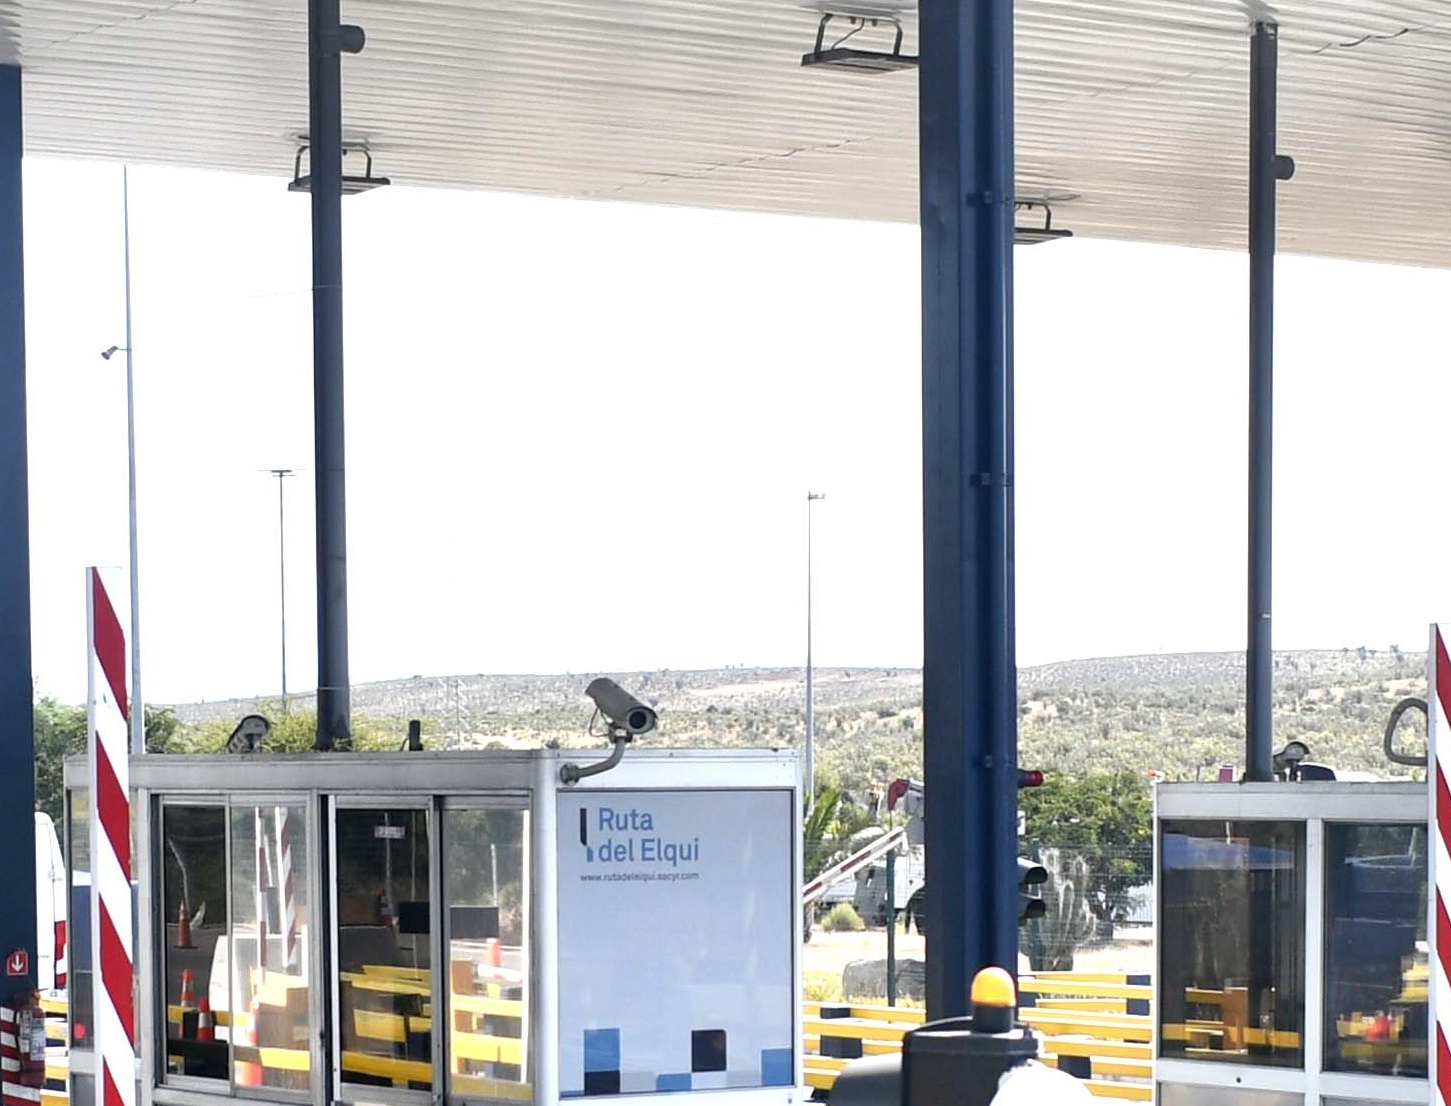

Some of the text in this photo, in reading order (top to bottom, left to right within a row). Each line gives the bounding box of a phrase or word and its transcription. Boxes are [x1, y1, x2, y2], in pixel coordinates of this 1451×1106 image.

[599, 807, 654, 831] Ruta
[598, 837, 699, 867] del Elqui
